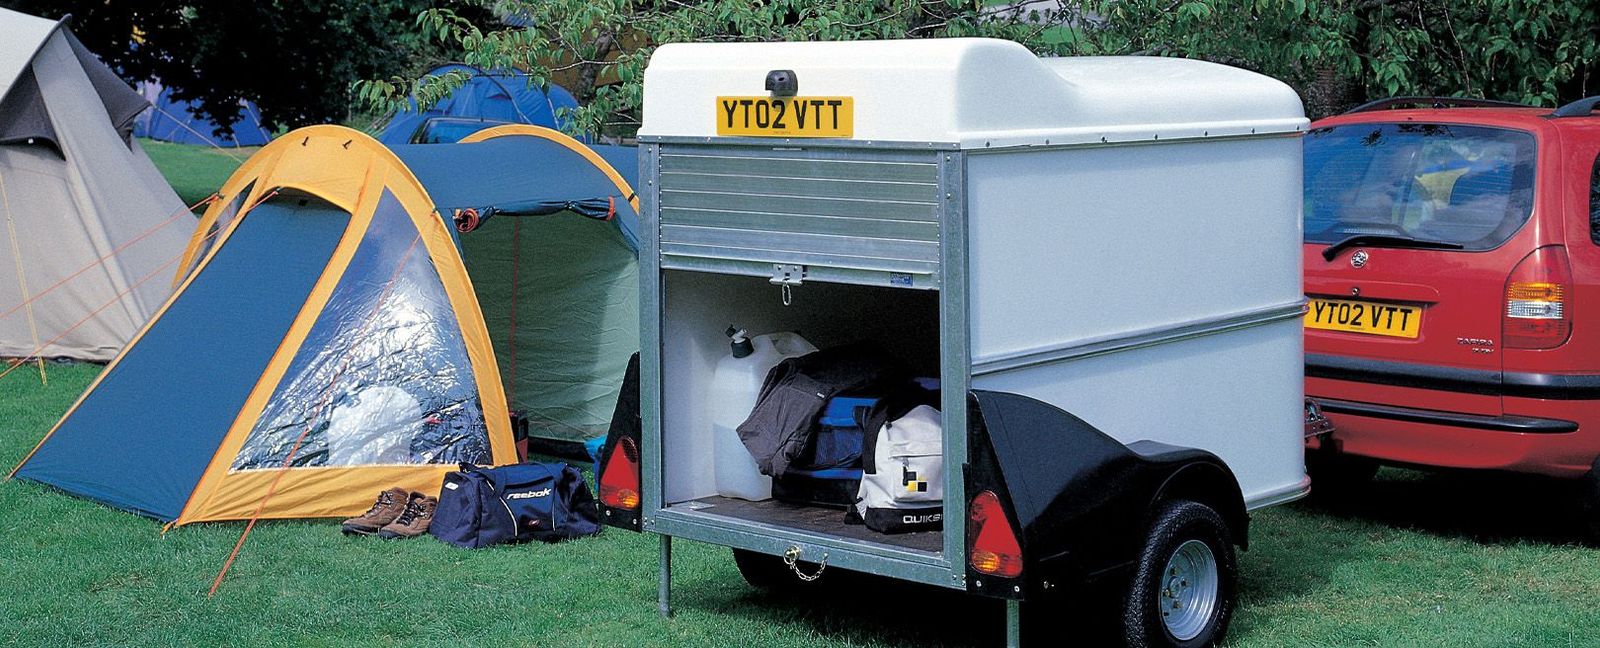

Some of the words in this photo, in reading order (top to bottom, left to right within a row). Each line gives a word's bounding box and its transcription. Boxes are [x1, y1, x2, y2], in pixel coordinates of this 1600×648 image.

[722, 99, 786, 129] YT02
[793, 99, 843, 130] VTT
[1314, 301, 1364, 326] YT02
[1371, 305, 1413, 331] VTT
